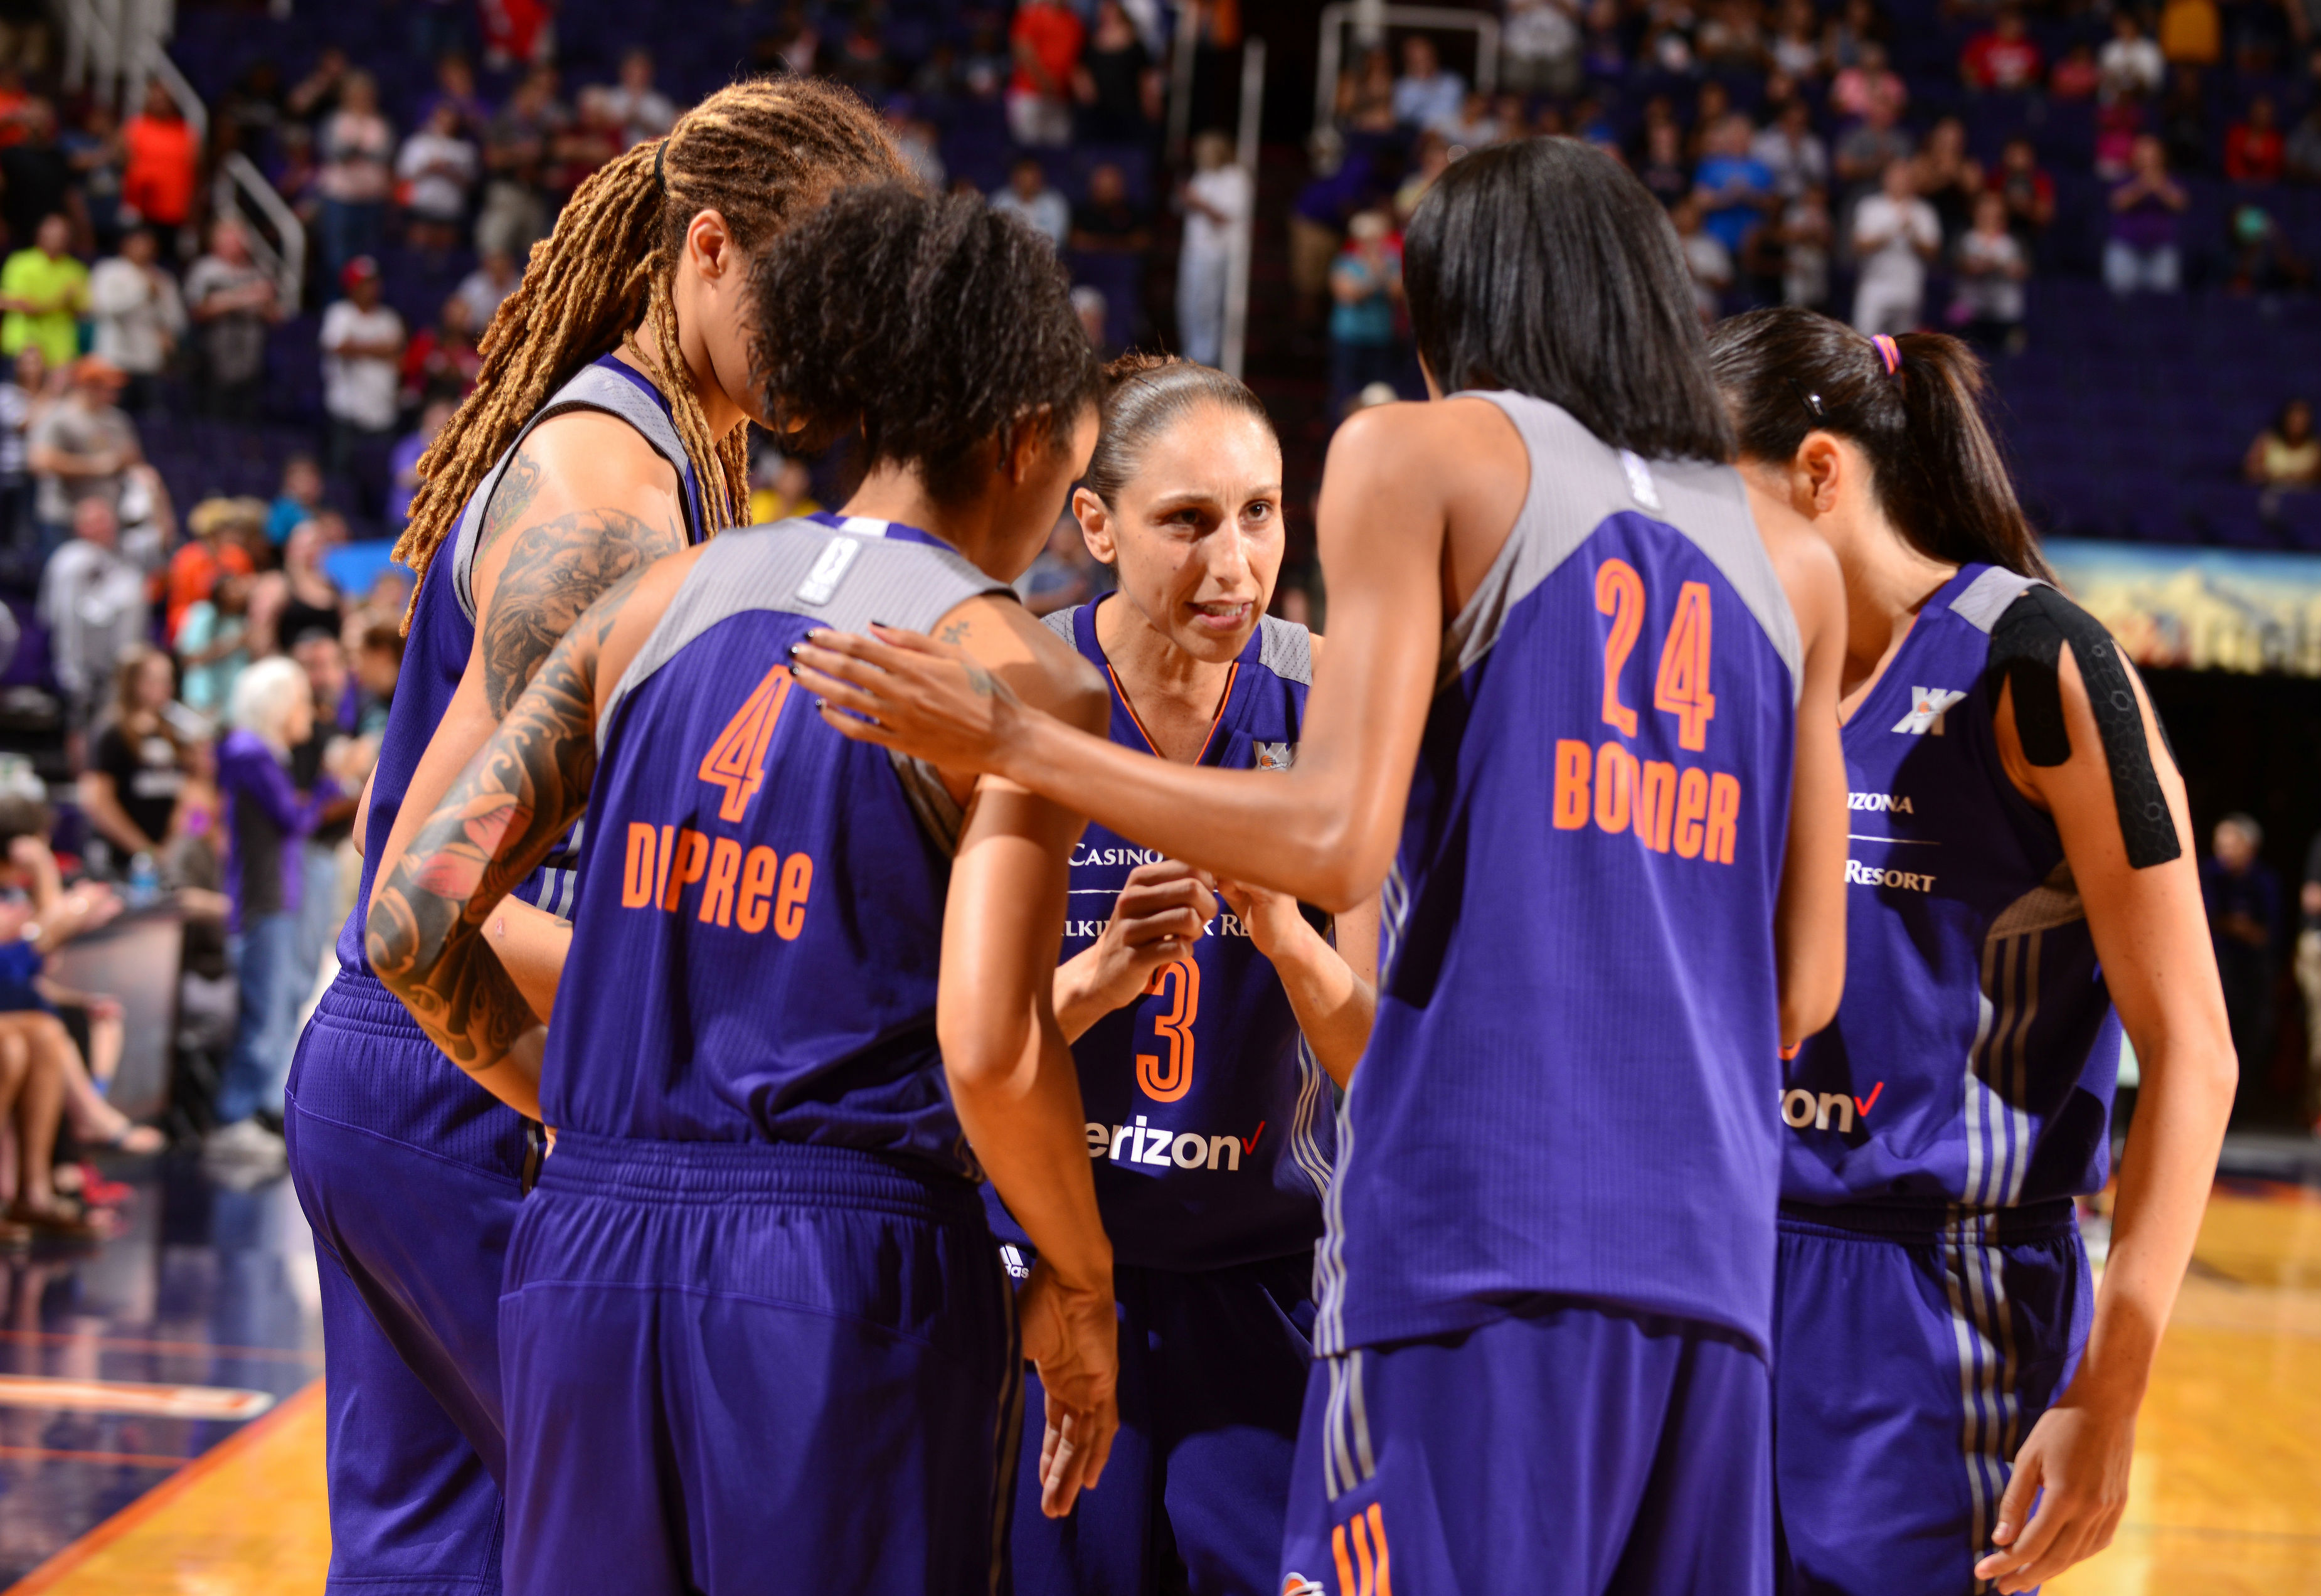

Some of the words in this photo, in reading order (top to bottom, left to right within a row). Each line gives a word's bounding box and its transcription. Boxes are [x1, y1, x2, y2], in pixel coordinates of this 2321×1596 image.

[1595, 558, 1715, 752] 24
[698, 664, 793, 822] 4
[1068, 843, 1164, 866] CASINO
[1844, 859, 1937, 893] RESORT
[1136, 956, 1200, 1103] 3
[1086, 1115, 1241, 1171] erizon
